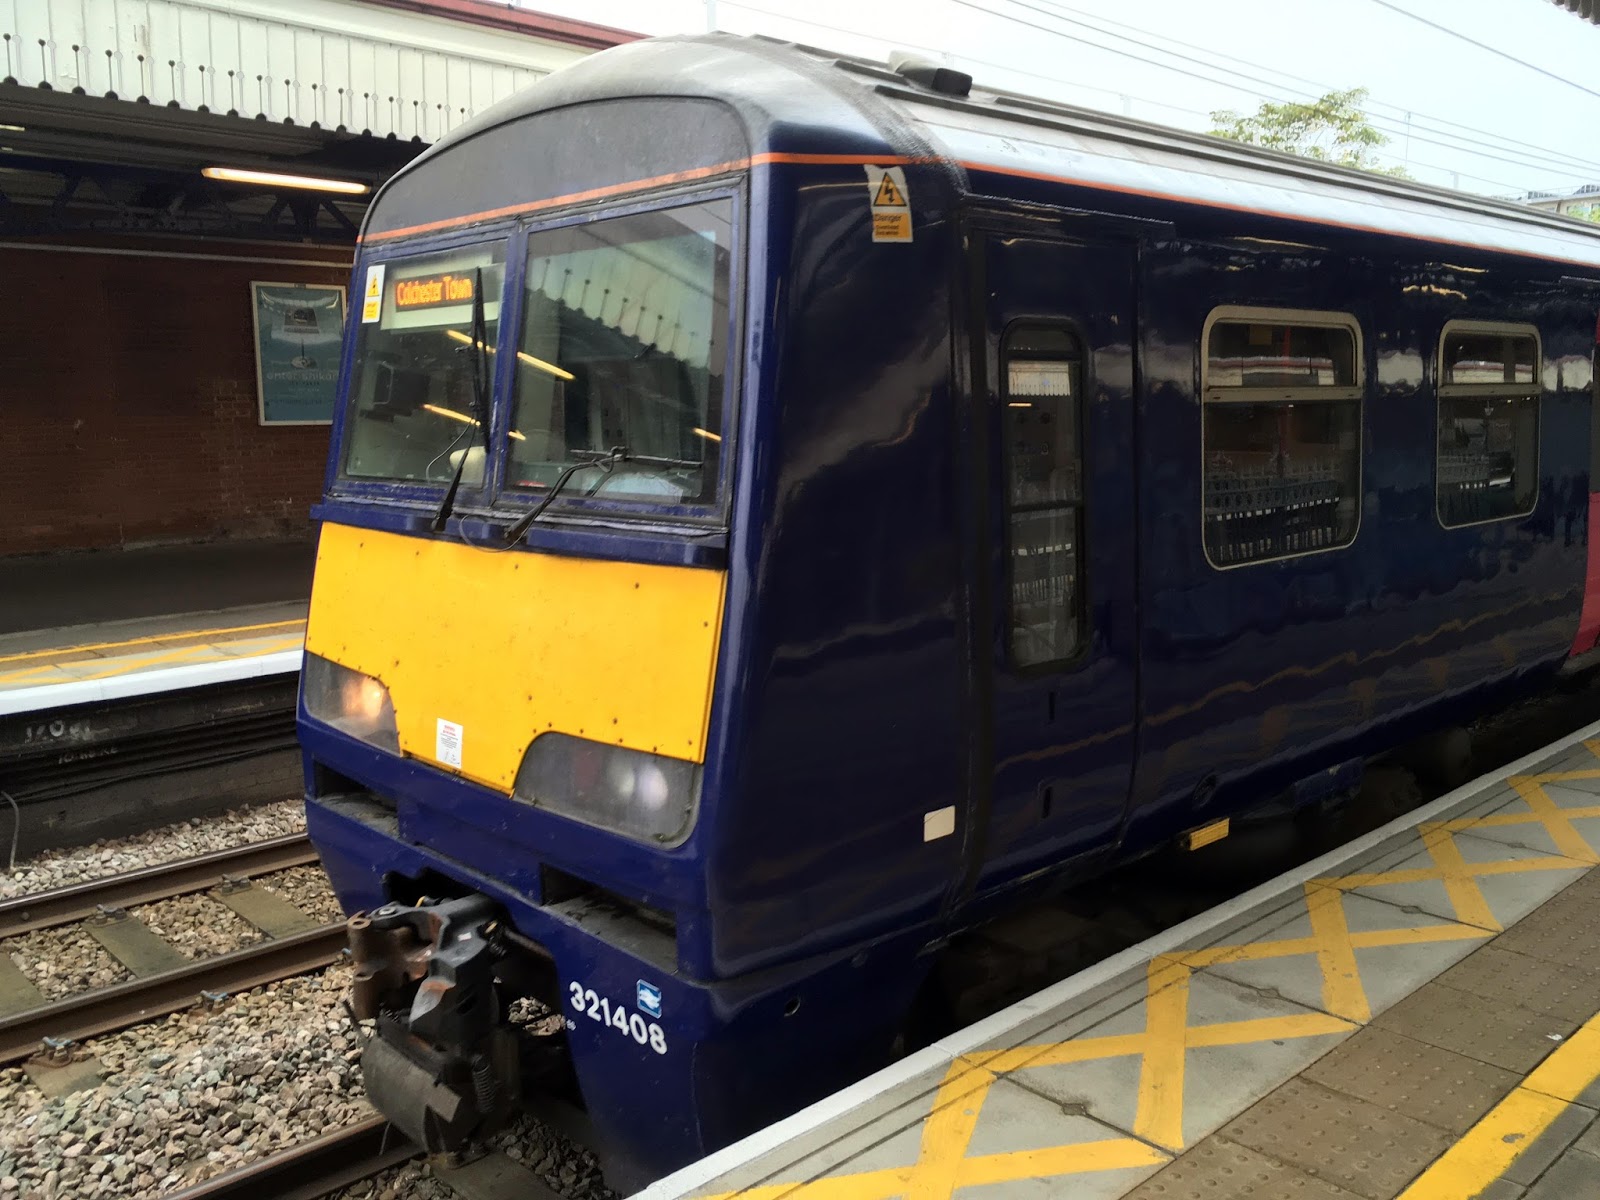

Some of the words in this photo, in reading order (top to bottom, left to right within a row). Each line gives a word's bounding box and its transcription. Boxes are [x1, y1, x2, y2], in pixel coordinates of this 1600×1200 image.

[397, 280, 443, 306] Colchester
[443, 275, 473, 300] Town
[301, 371, 338, 381] shikar
[569, 981, 667, 1055] 321408
